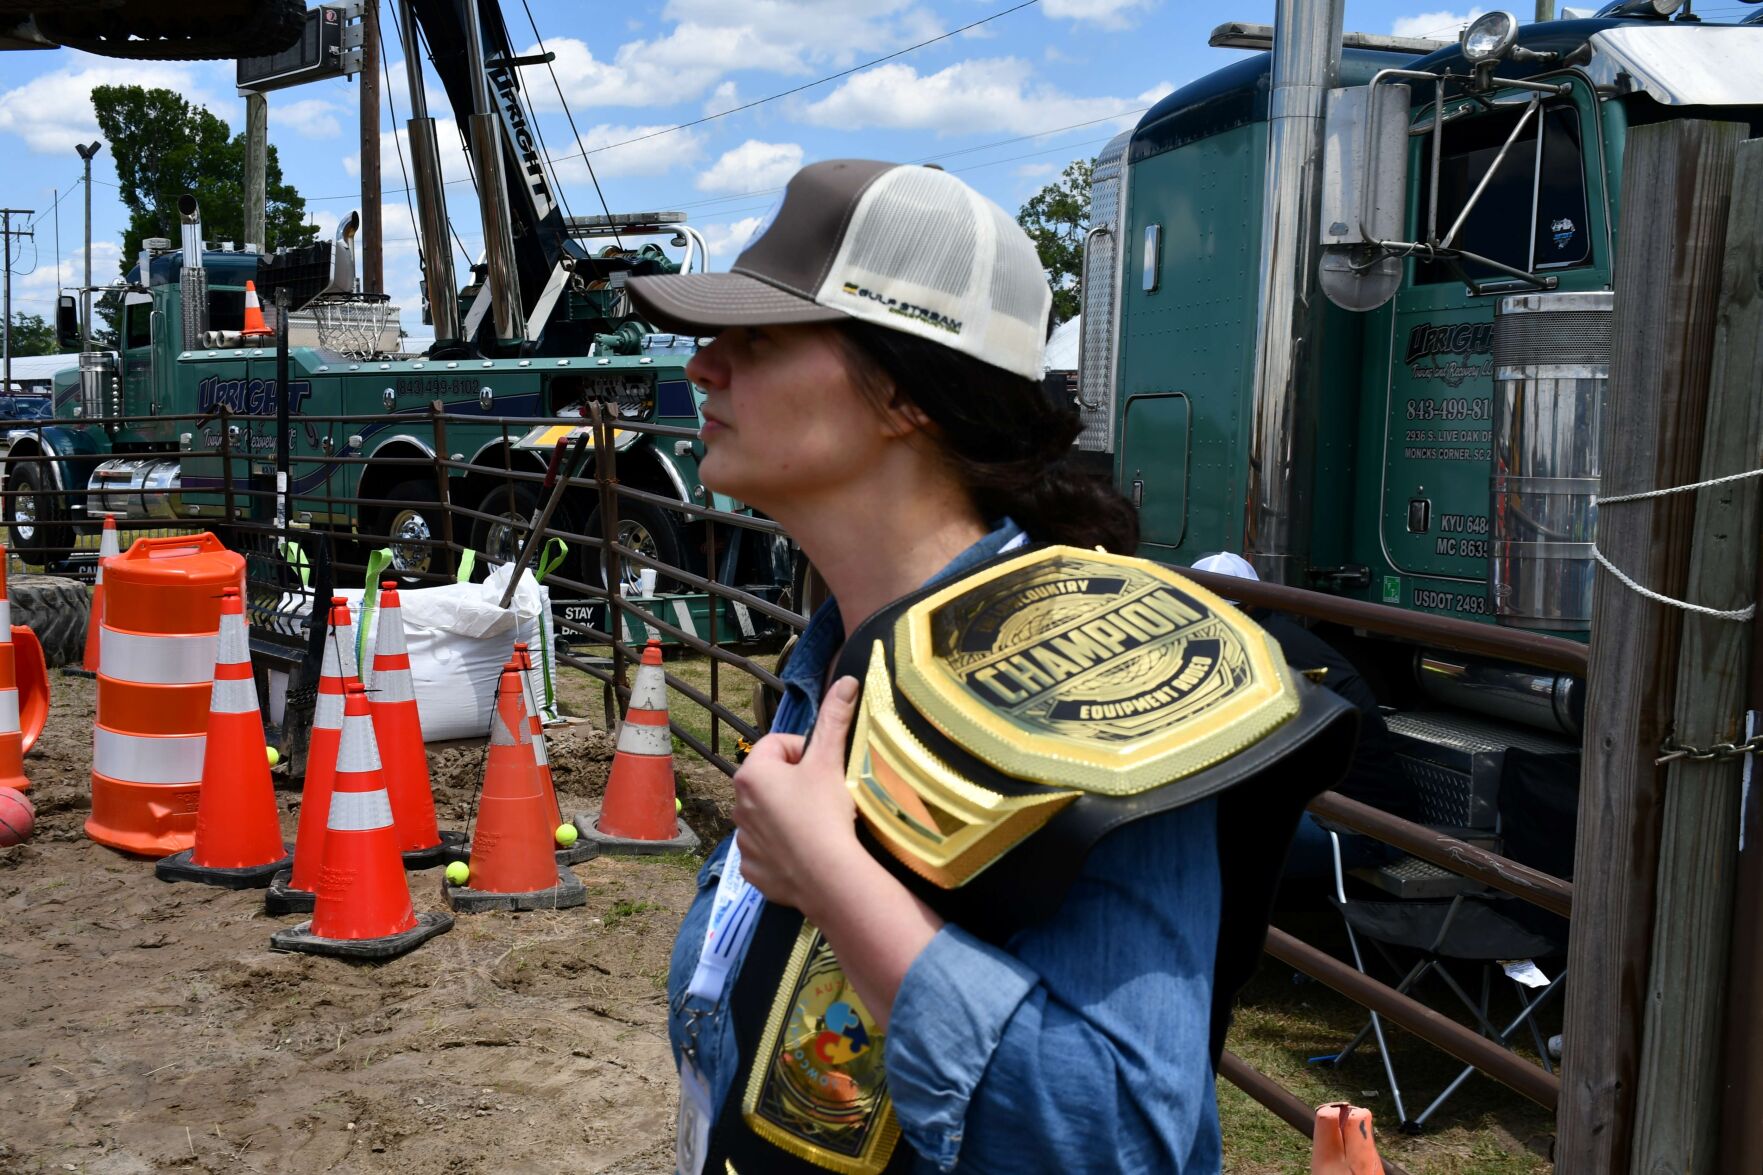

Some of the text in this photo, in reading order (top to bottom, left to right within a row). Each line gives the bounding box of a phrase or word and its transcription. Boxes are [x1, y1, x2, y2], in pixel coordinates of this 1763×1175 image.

[487, 67, 552, 203] UPRIGHT
[1405, 323, 1494, 364] UPRIGH
[1481, 359, 1494, 376] LL
[196, 376, 311, 429] UPRIGHT
[1407, 399, 1493, 420] 843-499-81
[204, 428, 224, 448] Towin
[1406, 431, 1426, 441] 2936
[1439, 431, 1458, 442] LIVE
[1460, 431, 1479, 442] OAK
[1405, 448, 1437, 459] MONCKS
[1473, 449, 1484, 460] SC
[1441, 515, 1464, 532] KYU
[1436, 539, 1455, 554] MC
[1414, 589, 1489, 614] USDOT 2493
[565, 606, 594, 620] STAY
[974, 588, 1202, 701] CHAMPION
[1080, 686, 1179, 719] EQUIPMENT
